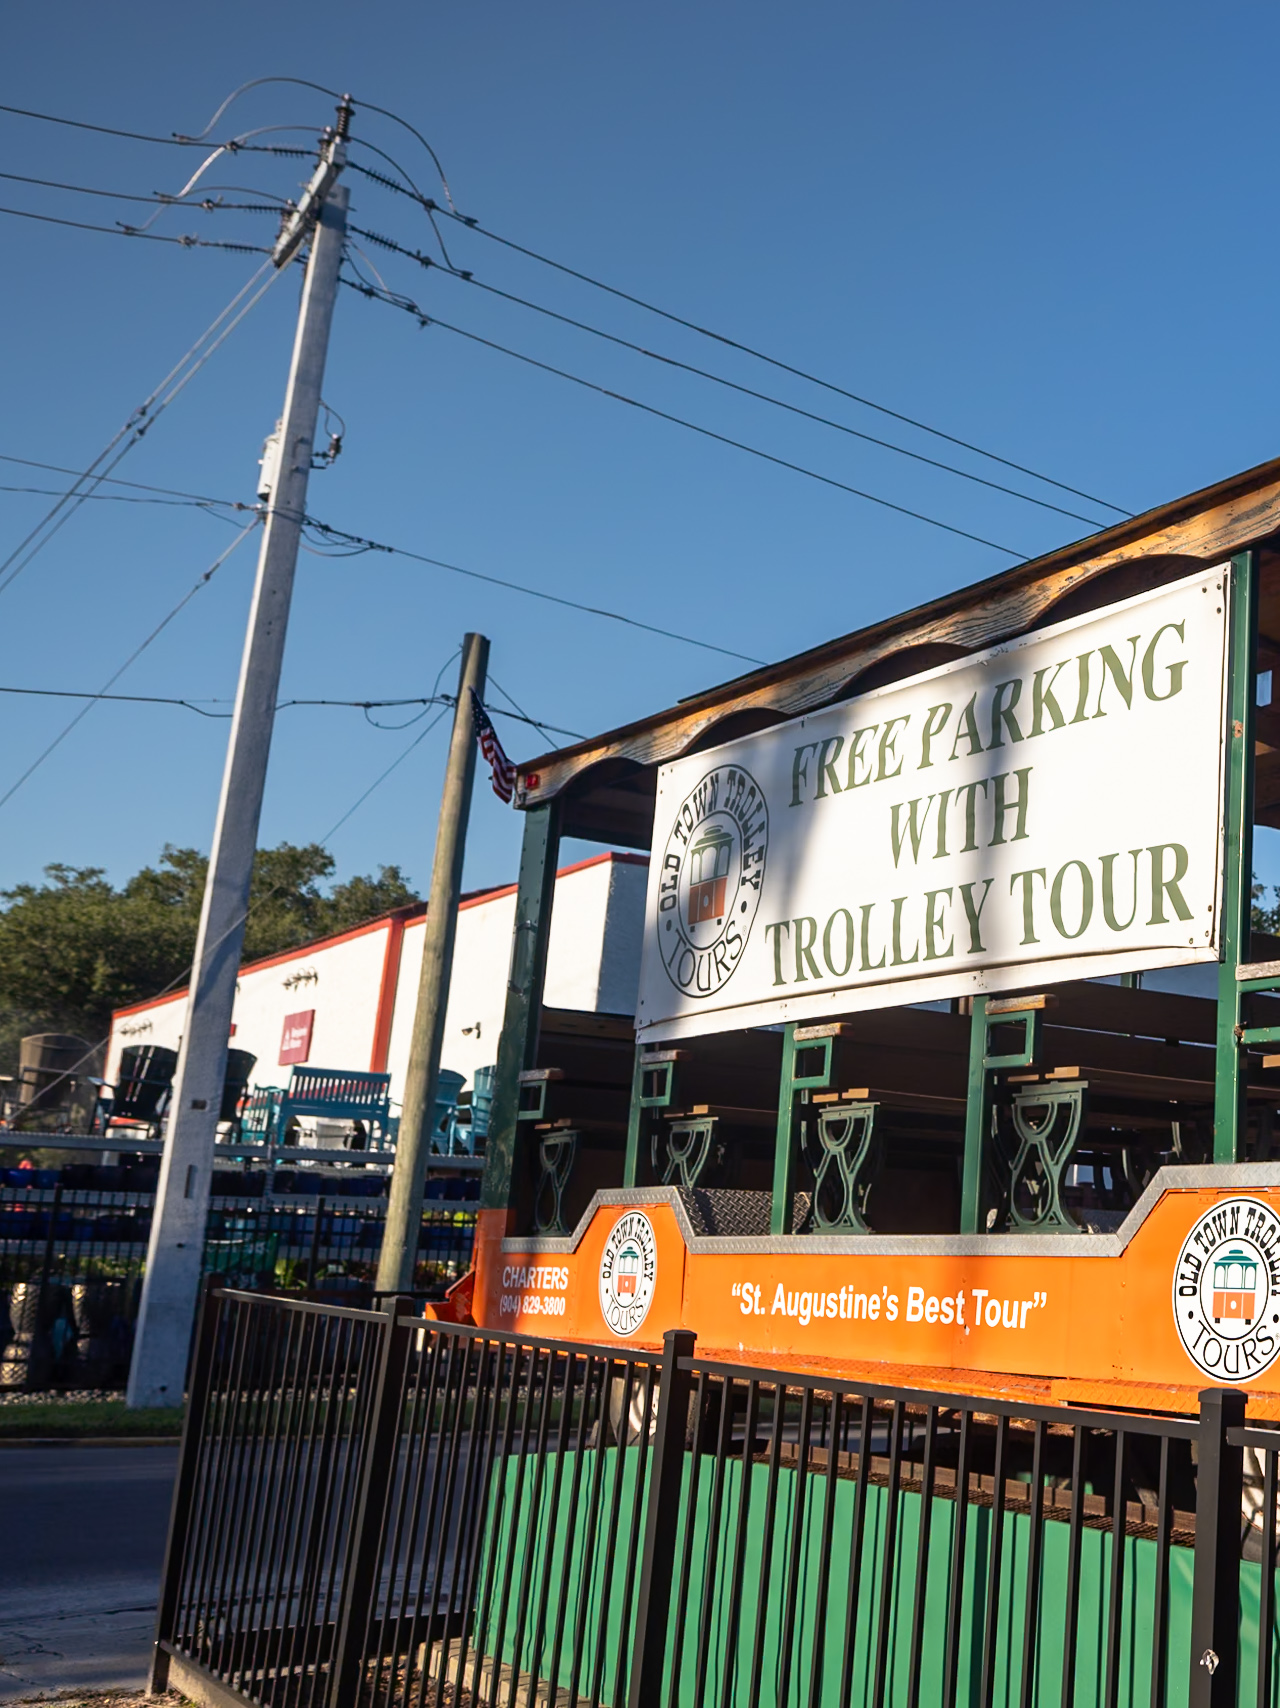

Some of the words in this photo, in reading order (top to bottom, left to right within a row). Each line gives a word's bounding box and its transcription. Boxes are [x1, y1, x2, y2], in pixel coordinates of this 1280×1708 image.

[789, 714, 911, 808] FREE
[920, 618, 1189, 768] PARKING
[660, 853, 681, 912] OLD
[673, 772, 719, 847] TOWN
[723, 769, 766, 891] TROLLEY
[890, 766, 1034, 869] WITH
[765, 878, 995, 986] TROLLEY
[1010, 842, 1194, 946] TOUR
[667, 920, 743, 992] TOURS
[502, 1266, 569, 1290] CHARTERS
[602, 1249, 615, 1279] OLD
[611, 1216, 635, 1249] TOWN
[1179, 1252, 1202, 1297] OLD
[1194, 1206, 1240, 1255] TOWN
[499, 1294, 521, 1318] (904)
[522, 1295, 566, 1316] 829-3800
[606, 1294, 645, 1330] TOURS
[731, 1281, 766, 1315] “St.
[770, 1282, 899, 1326] Augustine’s
[906, 1286, 965, 1326] Best
[971, 1288, 1047, 1330] Tour”
[1192, 1319, 1275, 1374] TOURS
